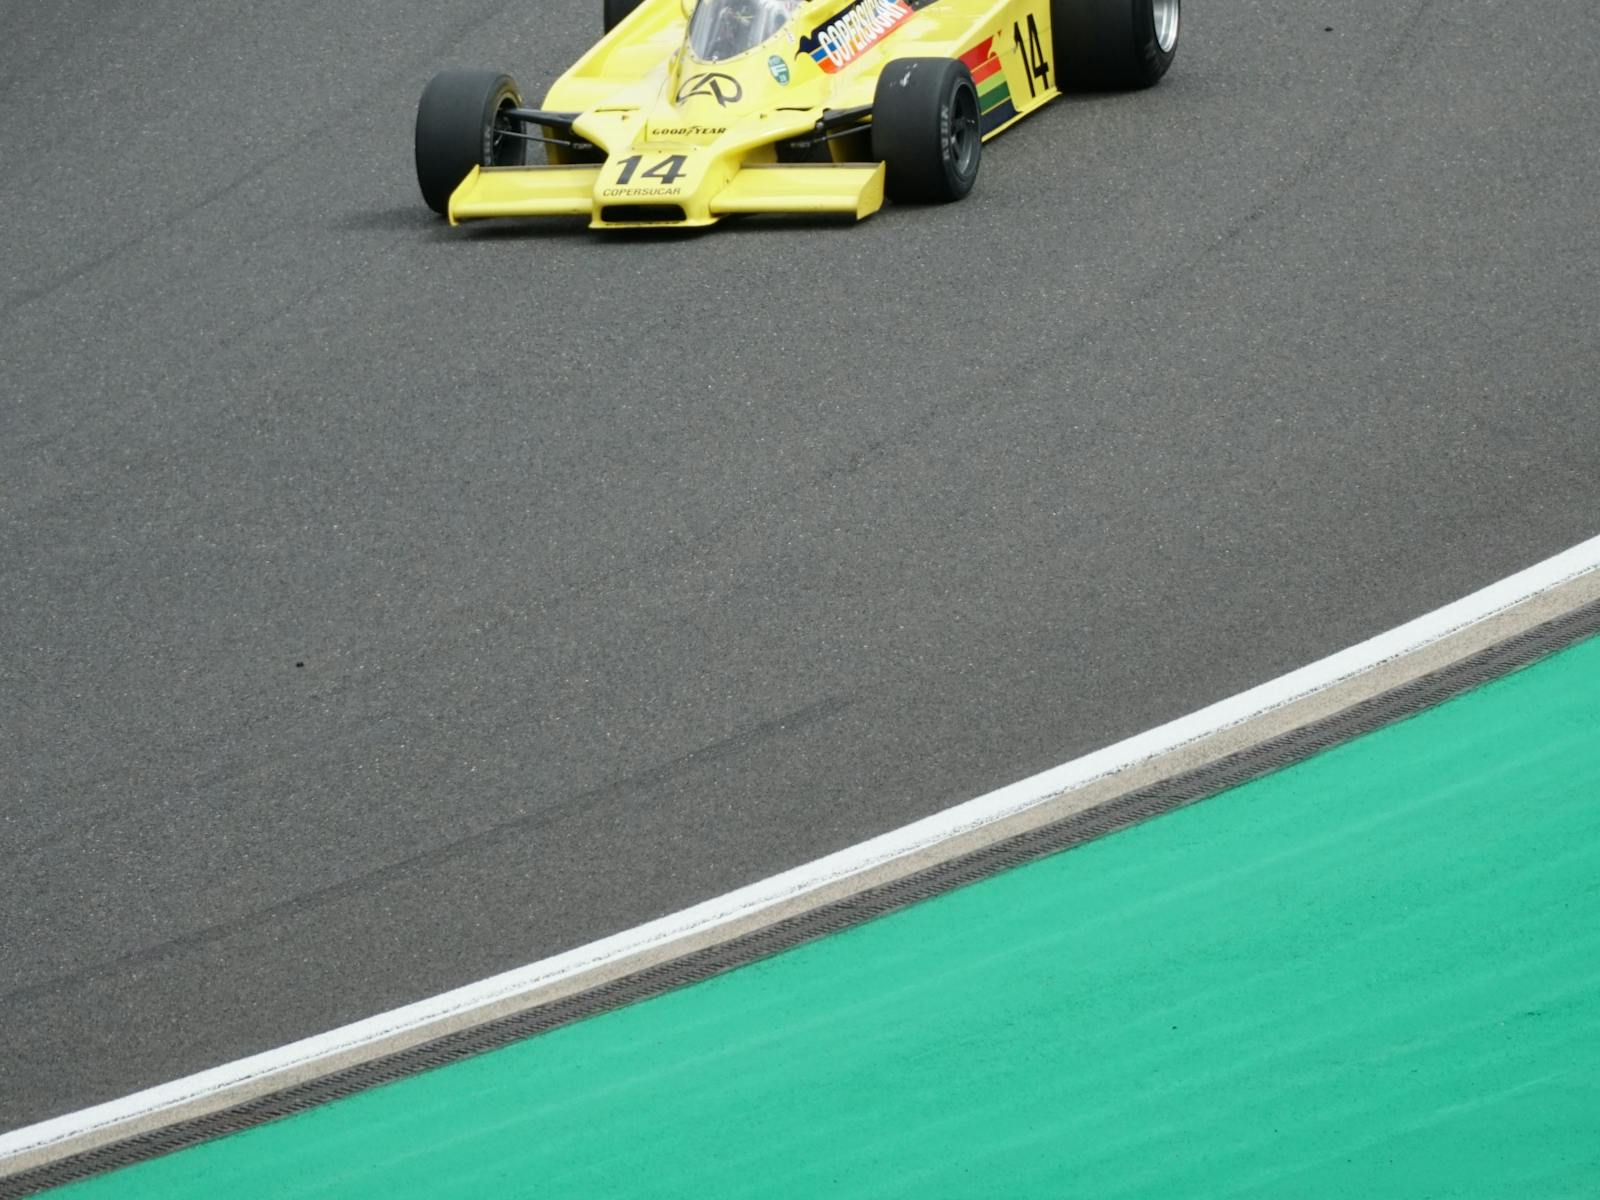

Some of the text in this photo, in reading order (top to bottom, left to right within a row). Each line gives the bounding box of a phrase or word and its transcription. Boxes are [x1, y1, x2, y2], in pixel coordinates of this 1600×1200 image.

[1012, 13, 1050, 98] 14
[615, 154, 689, 185] 14
[602, 187, 681, 197] COPERSUCAR
